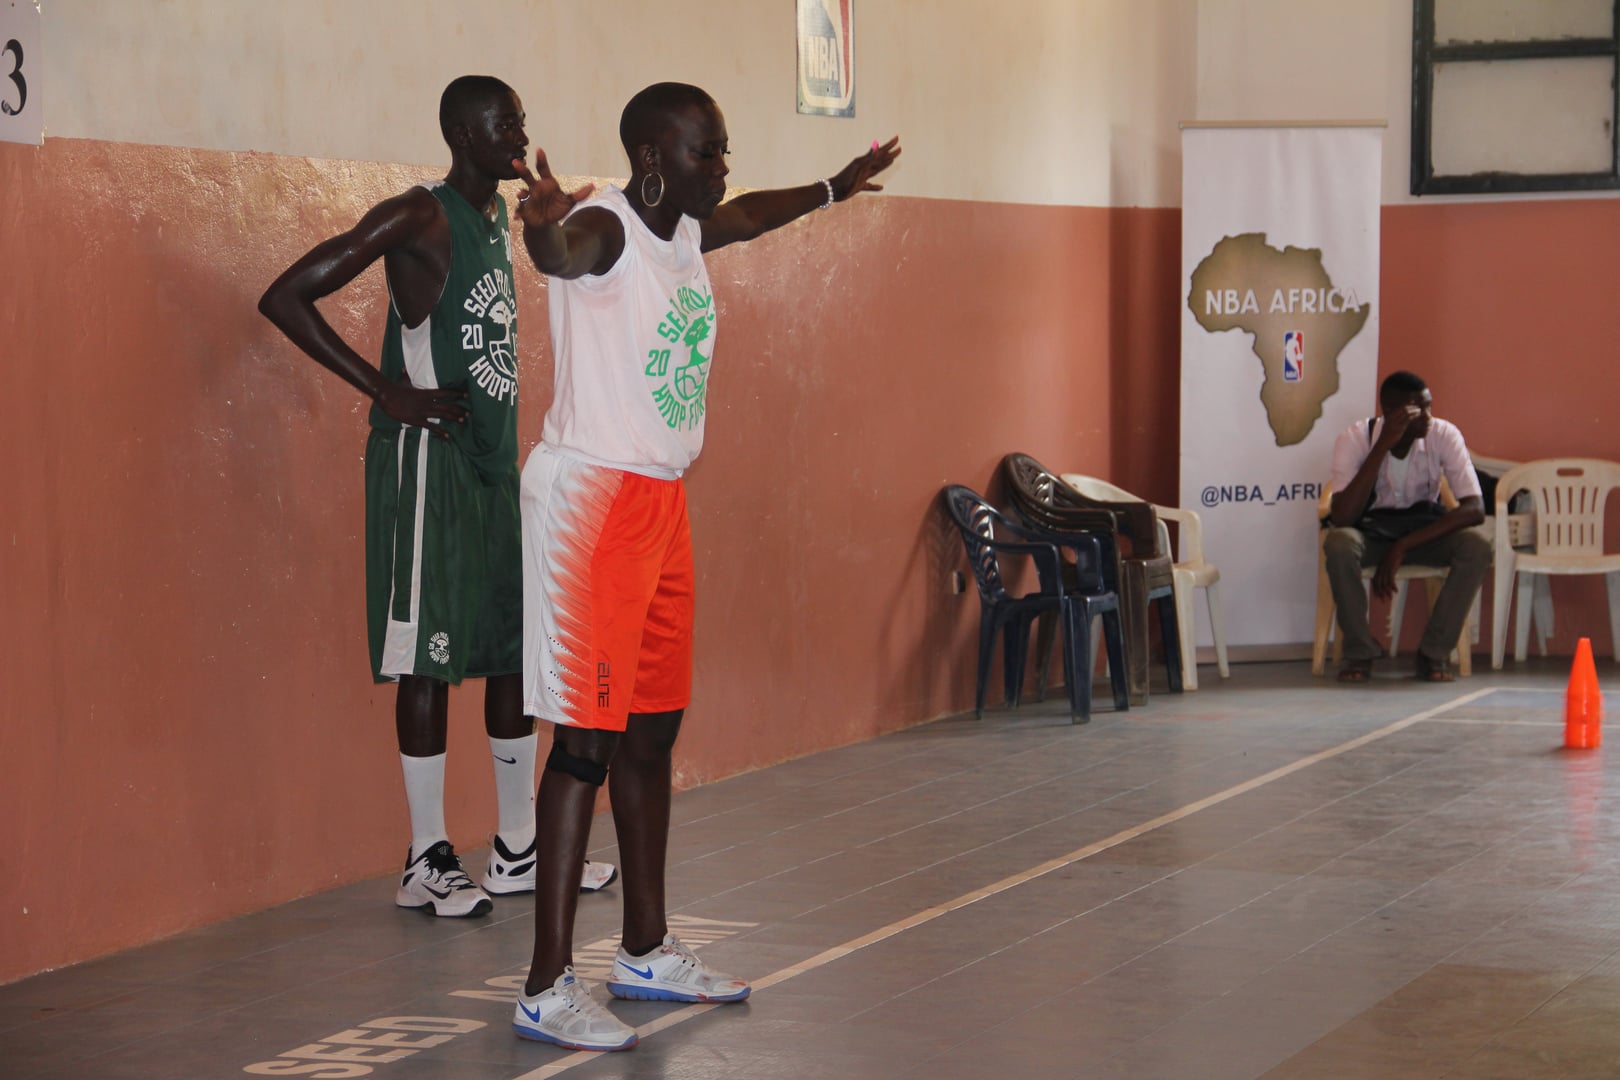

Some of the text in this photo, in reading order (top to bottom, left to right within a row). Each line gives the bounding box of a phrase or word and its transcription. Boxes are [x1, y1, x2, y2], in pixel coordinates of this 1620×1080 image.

[1, 38, 27, 116] 3
[806, 36, 839, 81] NBA
[463, 272, 498, 319] SEED
[1205, 287, 1361, 315] NBA AFRICA
[461, 323, 484, 350] 20
[468, 354, 511, 401] HOOP
[644, 349, 671, 377] 20
[1201, 482, 1322, 508] @NBA_AFRI
[242, 1015, 489, 1079] SEED
